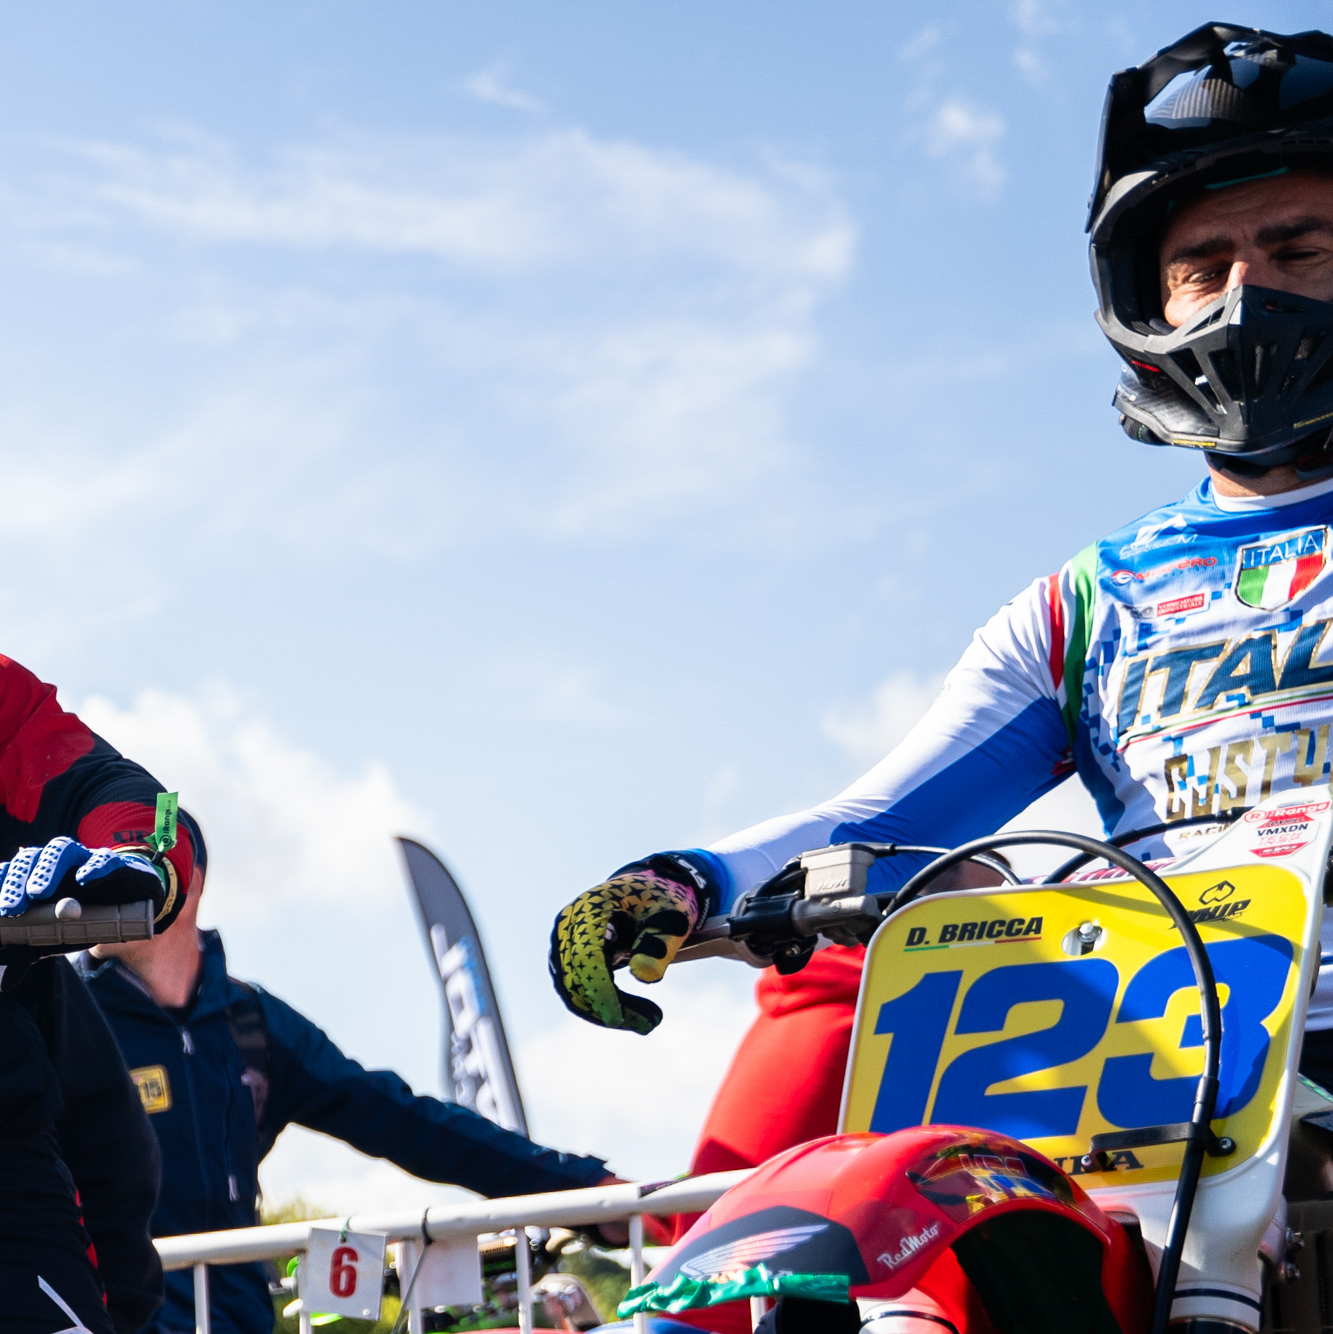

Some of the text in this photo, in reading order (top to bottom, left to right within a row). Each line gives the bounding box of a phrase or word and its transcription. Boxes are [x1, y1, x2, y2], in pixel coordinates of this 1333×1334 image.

[1250, 534, 1320, 568] ITALIA
[1257, 823, 1309, 837] VMXDN
[904, 917, 1043, 948] D. BRICCA
[869, 933, 1295, 1140] 123
[877, 1220, 940, 1271] RedMoto
[329, 1246, 358, 1299] 6
